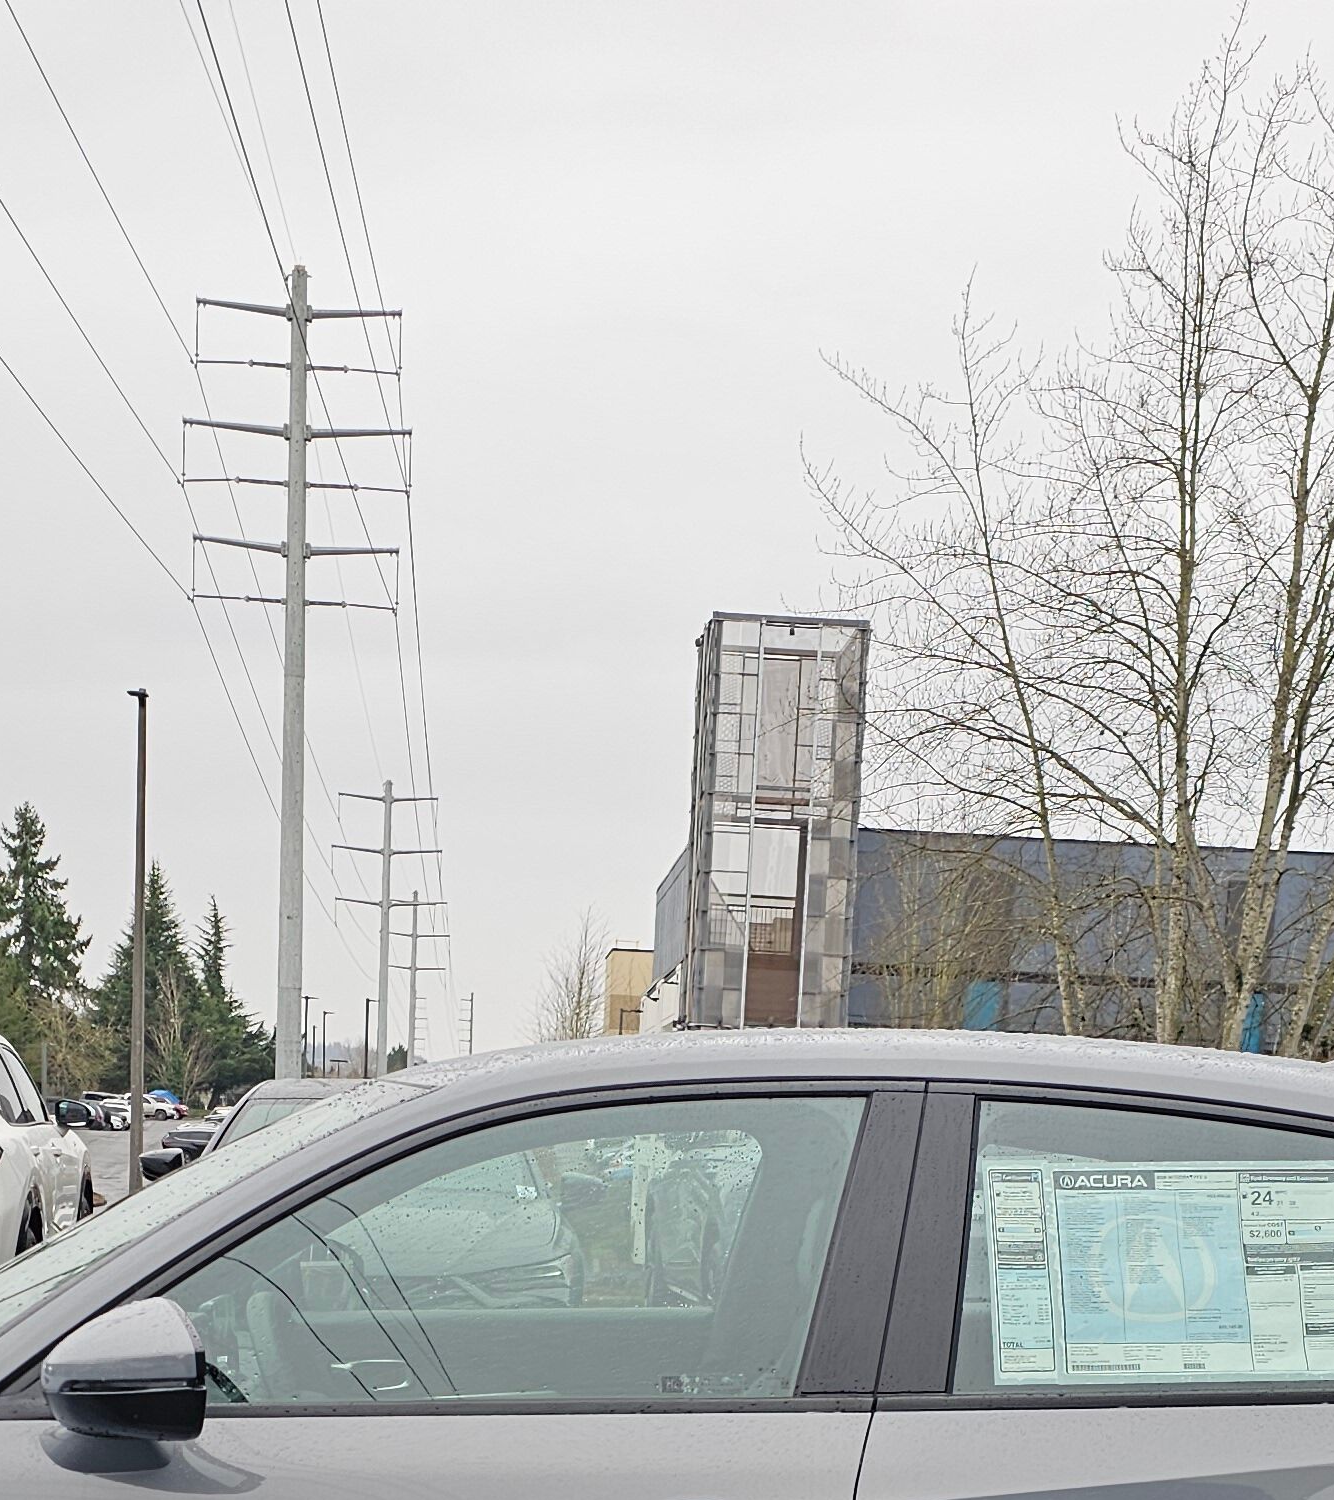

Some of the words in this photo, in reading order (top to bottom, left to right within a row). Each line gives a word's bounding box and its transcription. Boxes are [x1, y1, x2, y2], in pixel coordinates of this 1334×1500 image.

[1075, 1174, 1147, 1188] ACURA
[1250, 1190, 1274, 1206] 24
[1249, 1229, 1282, 1239] $2,600
